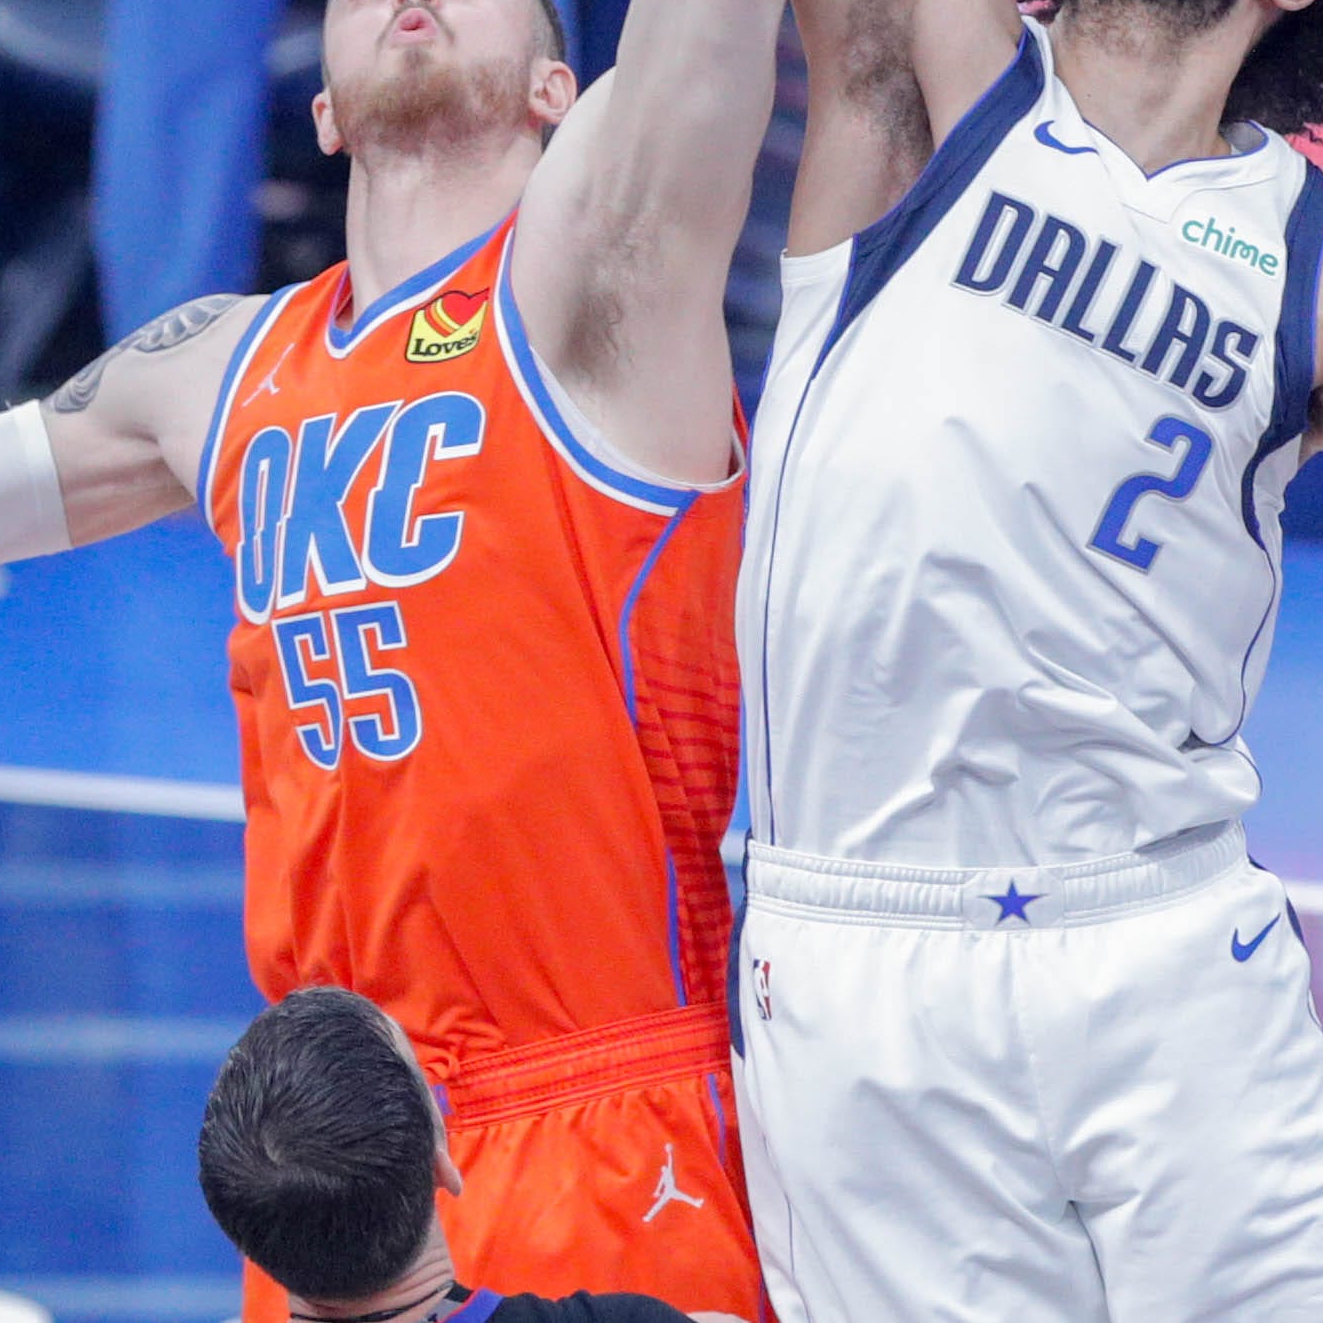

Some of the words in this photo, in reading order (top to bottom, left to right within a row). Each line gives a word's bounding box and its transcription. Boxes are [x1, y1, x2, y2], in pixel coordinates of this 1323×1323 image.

[948, 190, 1263, 411] DALLAS
[1182, 217, 1278, 276] chime
[236, 391, 486, 625] OKC
[1086, 413, 1214, 575] 2
[273, 601, 423, 770] 55
